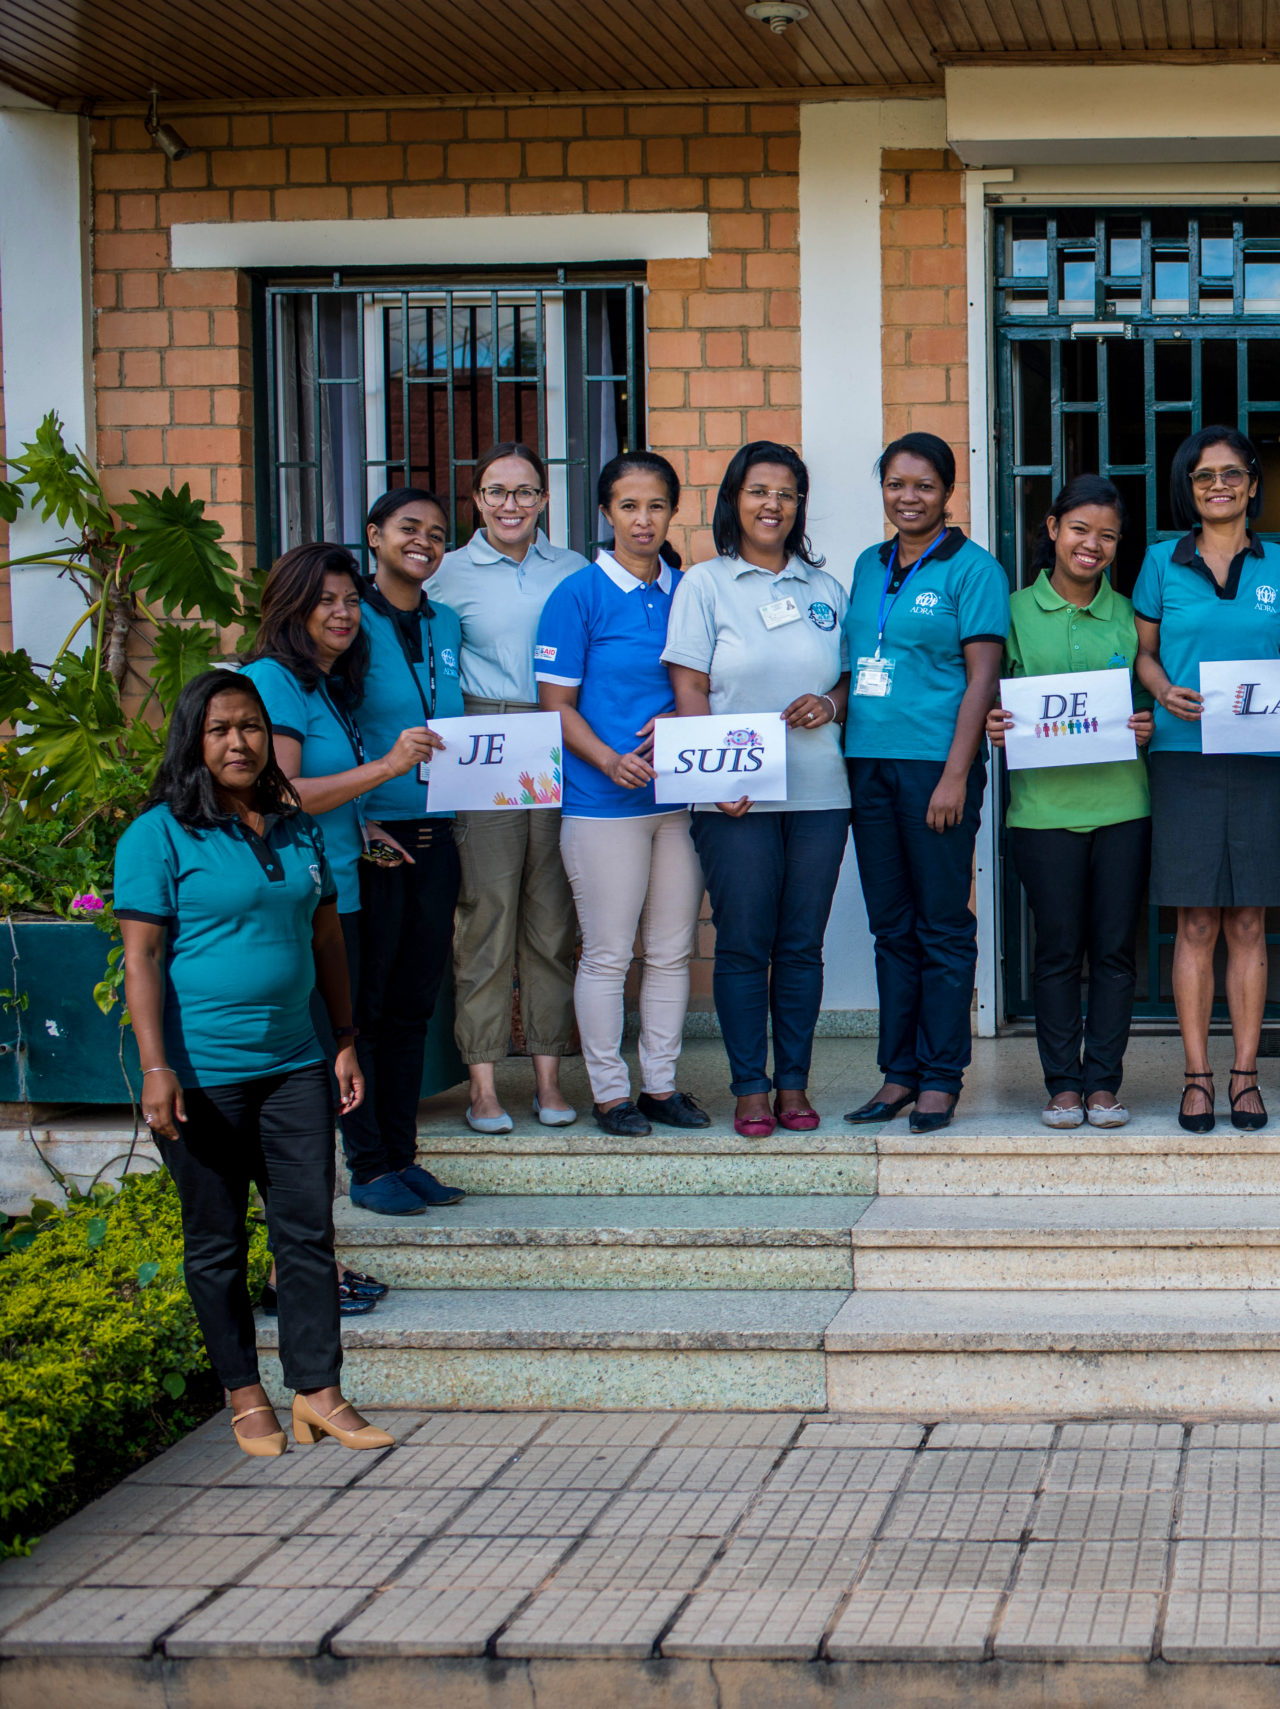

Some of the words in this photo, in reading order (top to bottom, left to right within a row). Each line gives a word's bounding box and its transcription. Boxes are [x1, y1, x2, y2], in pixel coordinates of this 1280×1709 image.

[910, 606, 934, 616] ADRA
[1254, 603, 1276, 613] ADRA
[1039, 692, 1088, 720] DE
[458, 733, 505, 765] JE
[674, 747, 765, 774] SUIS
